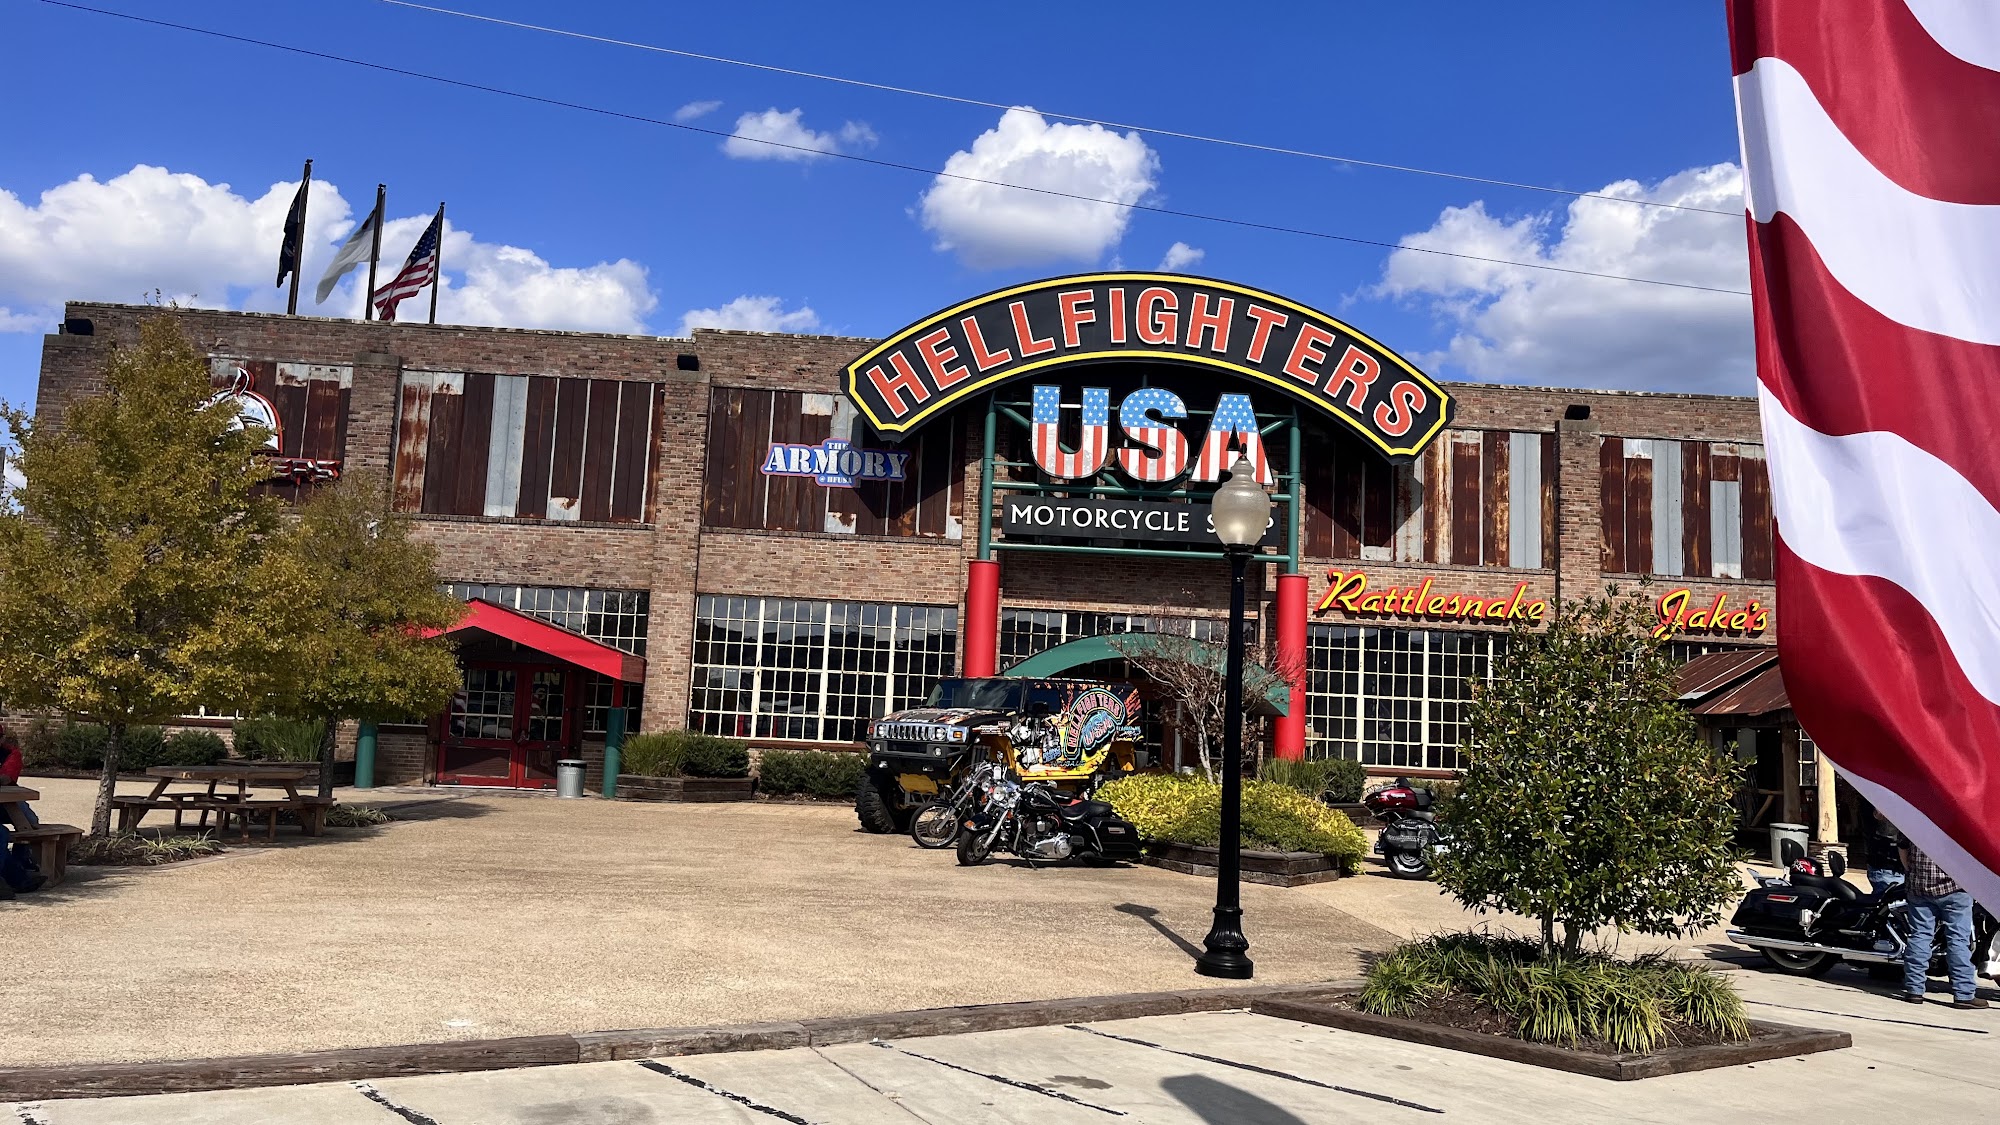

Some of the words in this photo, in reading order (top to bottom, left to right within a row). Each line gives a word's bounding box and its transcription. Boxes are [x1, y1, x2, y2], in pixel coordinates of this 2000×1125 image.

[866, 287, 1426, 437] HELLFIGHTERS
[827, 442, 849, 450] THE
[1031, 385, 1274, 486] USA
[765, 446, 909, 478] ARMORY
[1011, 504, 1190, 532] MOTORCYCLE
[1318, 571, 1546, 621] Rattlesnake
[1653, 589, 1769, 641] Jake's
